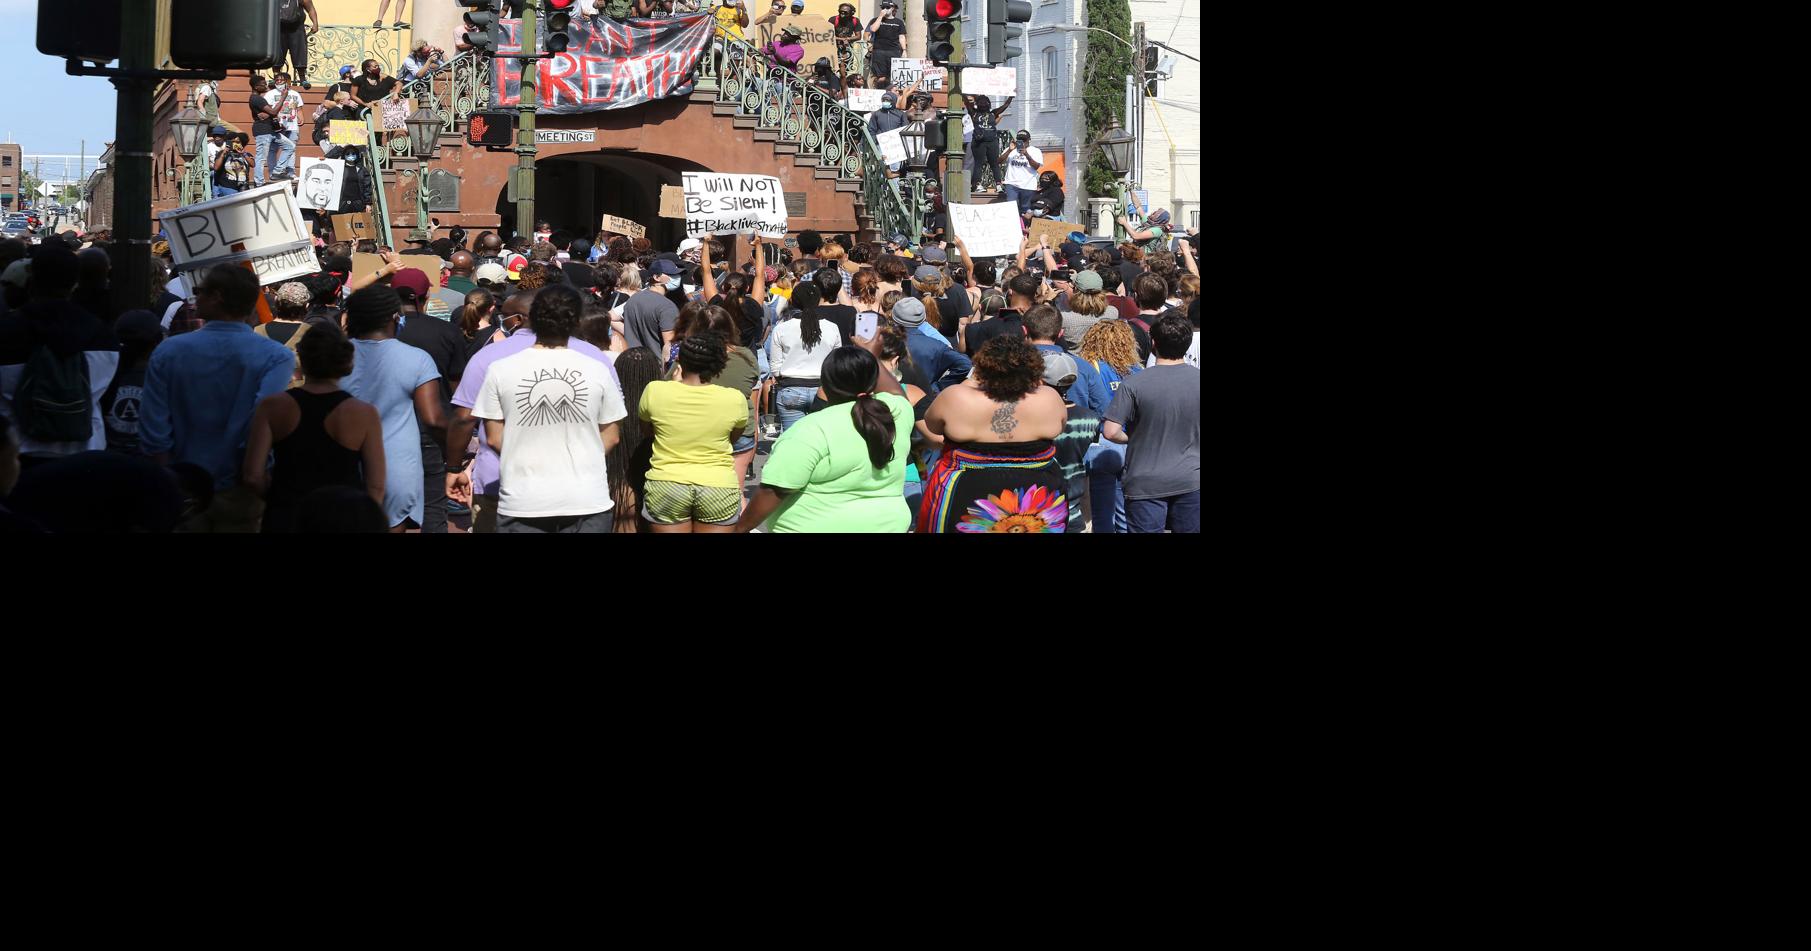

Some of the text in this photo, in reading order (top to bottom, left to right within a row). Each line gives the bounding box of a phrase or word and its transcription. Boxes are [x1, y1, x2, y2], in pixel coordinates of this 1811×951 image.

[537, 132, 583, 142] MEETING
[682, 174, 699, 196] I
[704, 177, 733, 193] Will
[740, 177, 777, 194] NOT
[686, 196, 714, 214] Be
[175, 196, 289, 257] BLM
